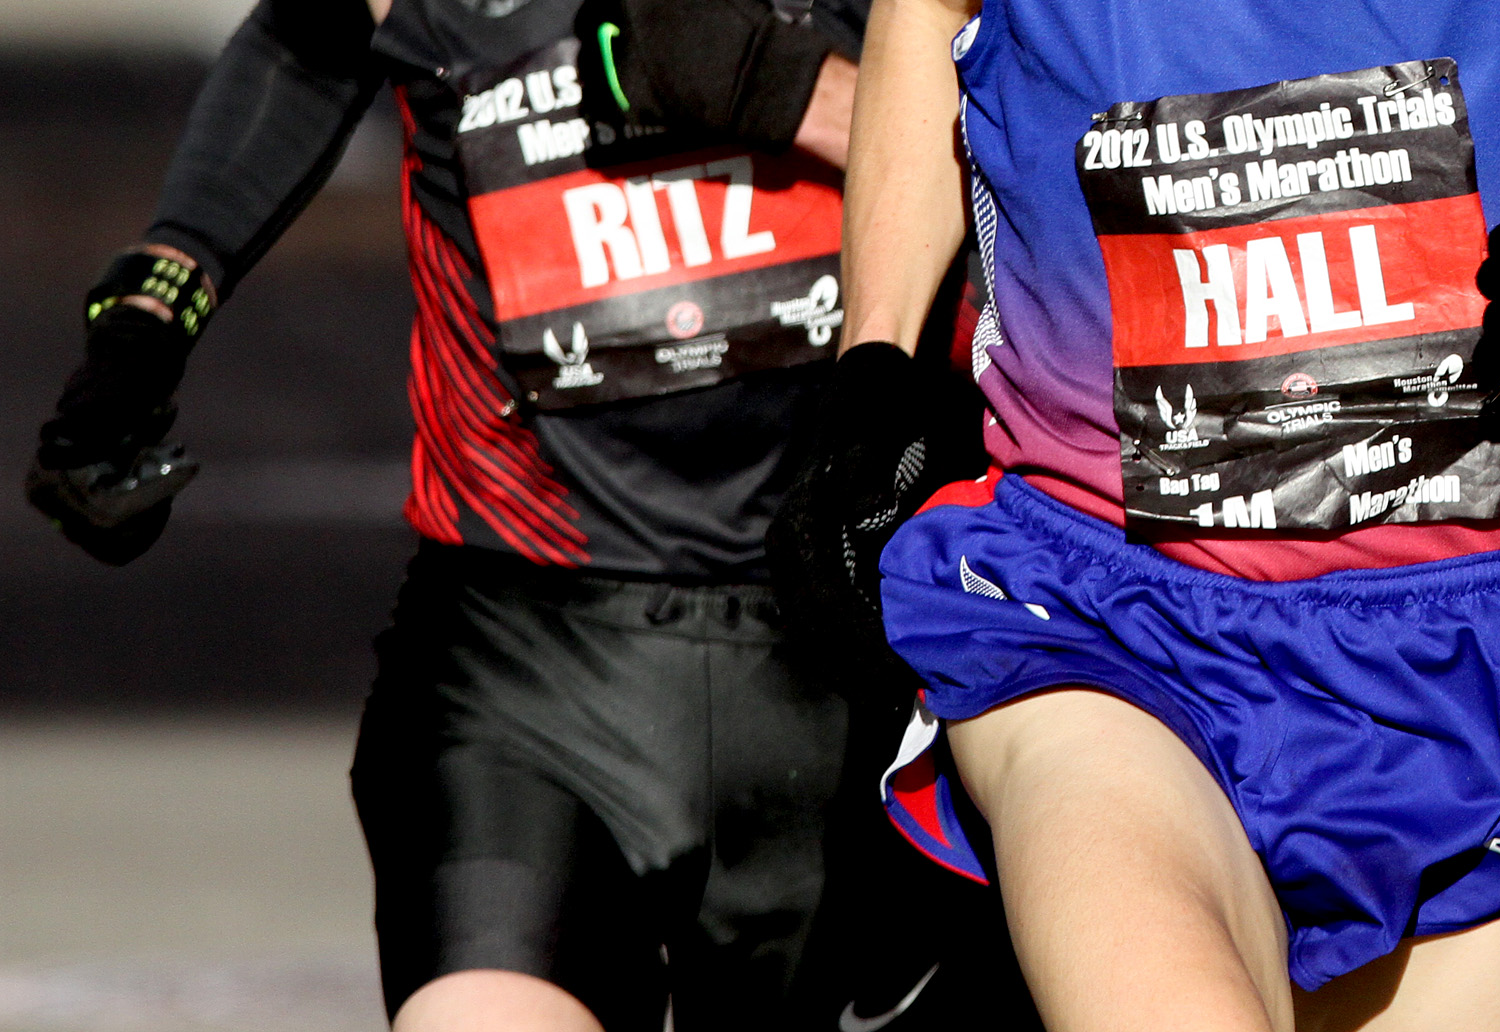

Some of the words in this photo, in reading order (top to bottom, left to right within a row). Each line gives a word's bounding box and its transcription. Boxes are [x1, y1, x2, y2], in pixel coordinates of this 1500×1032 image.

[525, 65, 582, 113] U.S
[1083, 128, 1152, 171] 2012
[1156, 120, 1219, 164] U.S.
[1222, 102, 1354, 156] Olympic
[1357, 88, 1456, 134] Trials
[1142, 168, 1241, 216] Men's
[1245, 147, 1412, 203] Marathon
[562, 156, 776, 289] RITZ
[1173, 225, 1415, 348] HALL
[1394, 375, 1433, 387] Houston
[1266, 401, 1341, 424] OLYMPIC
[1281, 412, 1334, 433] TRIALS
[1165, 429, 1199, 444] USA
[1343, 435, 1412, 478] Men's
[1160, 477, 1189, 496] Bag
[1190, 472, 1220, 492] Tag
[1350, 475, 1460, 525] Marathon
